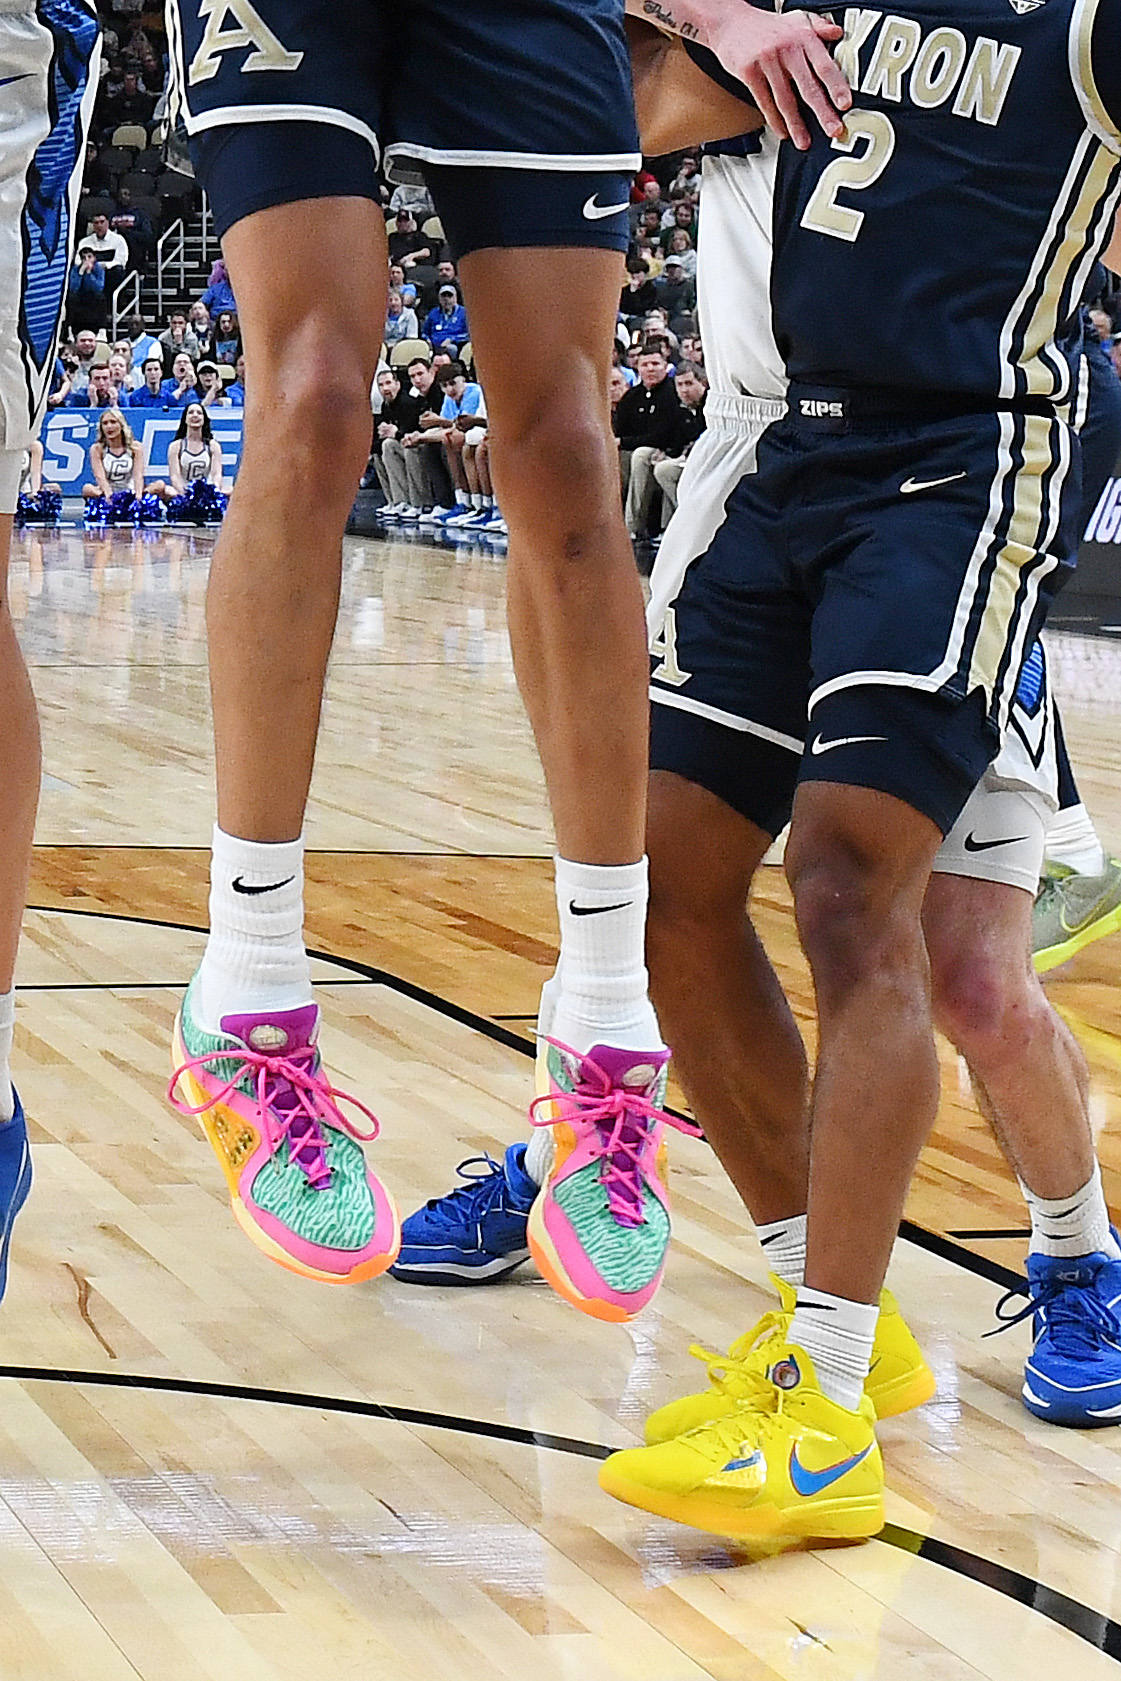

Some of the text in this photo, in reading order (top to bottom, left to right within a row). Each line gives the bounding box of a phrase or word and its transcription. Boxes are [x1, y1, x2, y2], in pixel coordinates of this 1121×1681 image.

[820, 7, 1022, 126] KRON
[800, 108, 895, 242] 2
[799, 399, 843, 418] ZIPS
[107, 460, 129, 481] C
[186, 460, 207, 481] C
